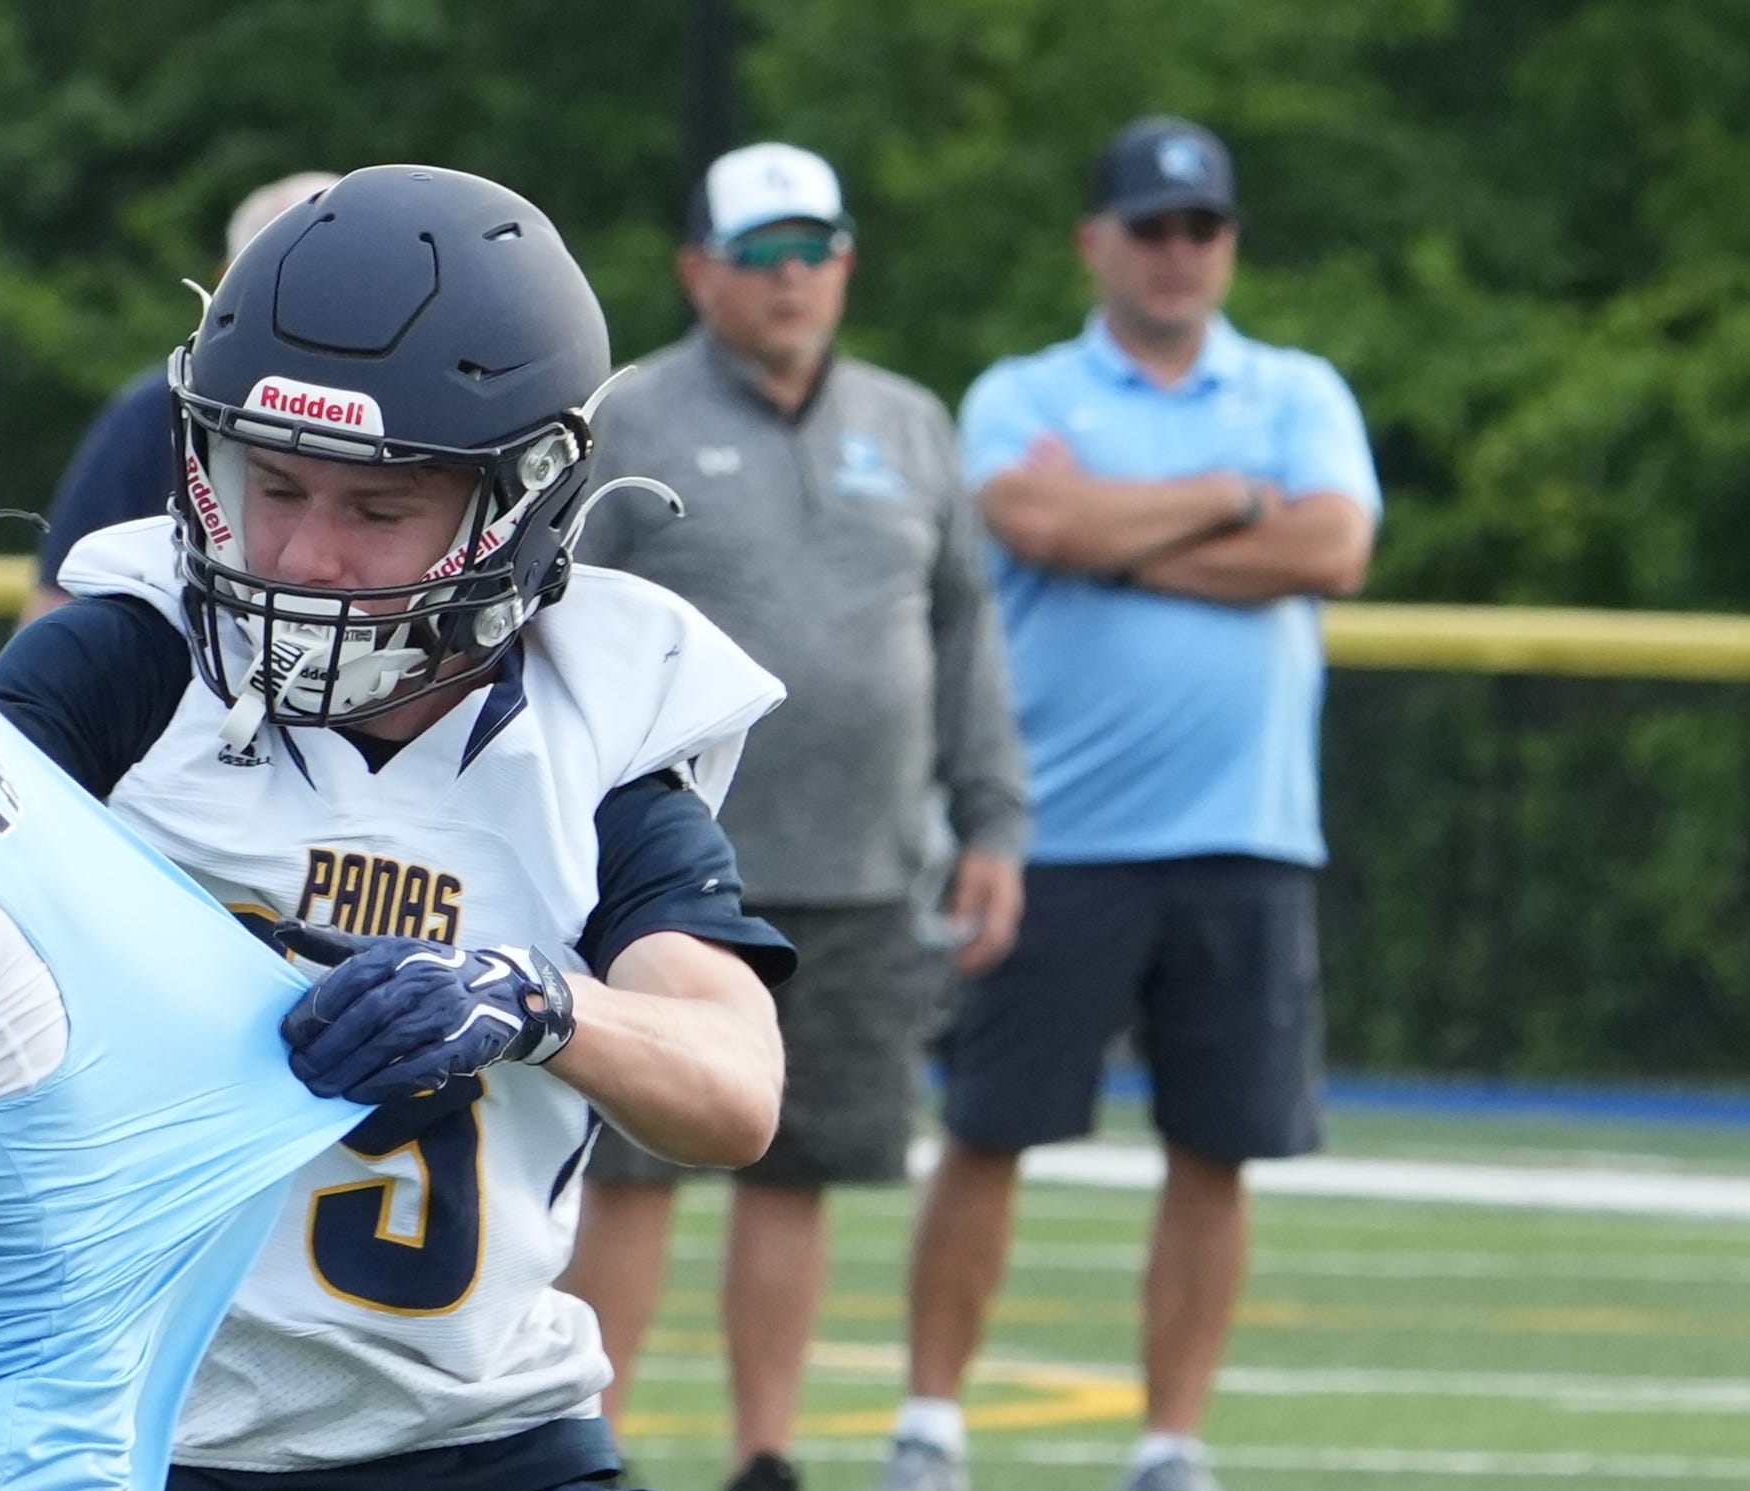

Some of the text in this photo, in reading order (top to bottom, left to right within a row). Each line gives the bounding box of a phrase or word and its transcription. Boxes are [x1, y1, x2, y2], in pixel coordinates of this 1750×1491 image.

[260, 385, 364, 426] Riddell
[186, 456, 233, 545] Riddell
[296, 848, 462, 946] PANAS
